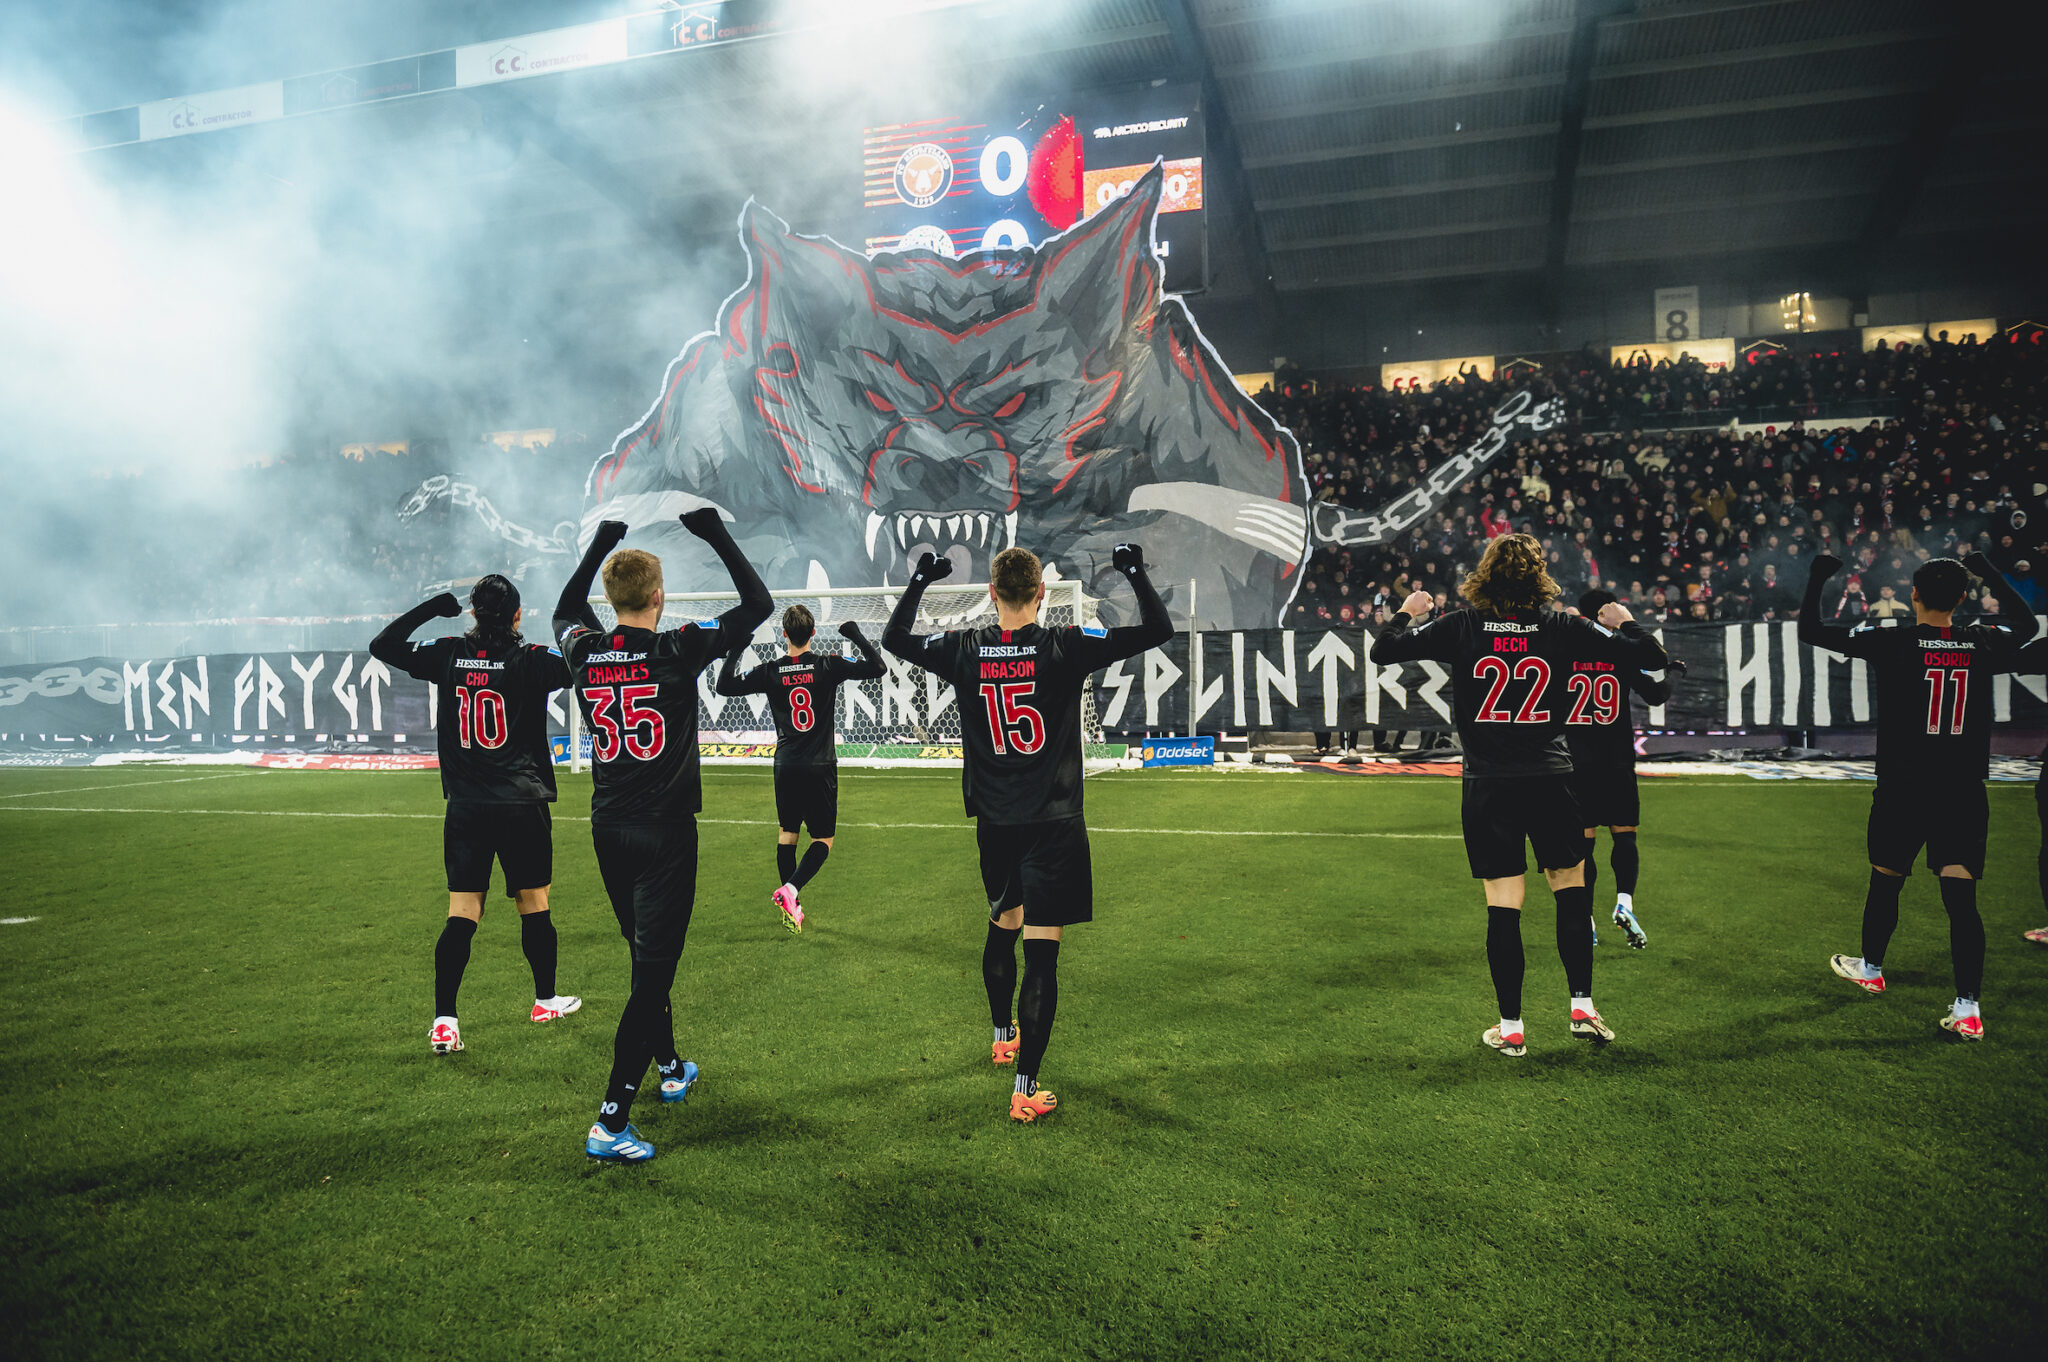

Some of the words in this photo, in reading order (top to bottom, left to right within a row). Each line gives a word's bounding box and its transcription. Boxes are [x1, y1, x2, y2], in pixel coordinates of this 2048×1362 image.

[979, 135, 1029, 197] 0
[1666, 309, 1690, 341] 8
[1482, 621, 1540, 634] HESSEL.DK
[977, 645, 1038, 658] HESSEL.DK
[1493, 636, 1528, 653] BECH
[1917, 638, 1977, 650] HESSEL.DK
[454, 658, 505, 670] HESSEL.DK
[584, 650, 649, 664] HESSEL.DK
[1924, 652, 1971, 667] OSORIO
[587, 662, 650, 686] CHARLES
[777, 662, 815, 675] HESSEL.DK
[979, 660, 1036, 680] INGASON
[465, 671, 489, 687] CHO
[781, 672, 814, 687] OLSSON
[122, 655, 210, 731] MEN
[233, 652, 392, 731] FRYGT
[1472, 655, 1551, 724] 22
[1564, 672, 1621, 726] 29
[1923, 667, 1970, 736] 11
[455, 684, 509, 750] 10
[788, 686, 816, 733] 8
[978, 680, 1047, 755] 15
[581, 683, 666, 763] 35
[918, 747, 964, 758] FAX
[1155, 745, 1209, 759] Oddset
